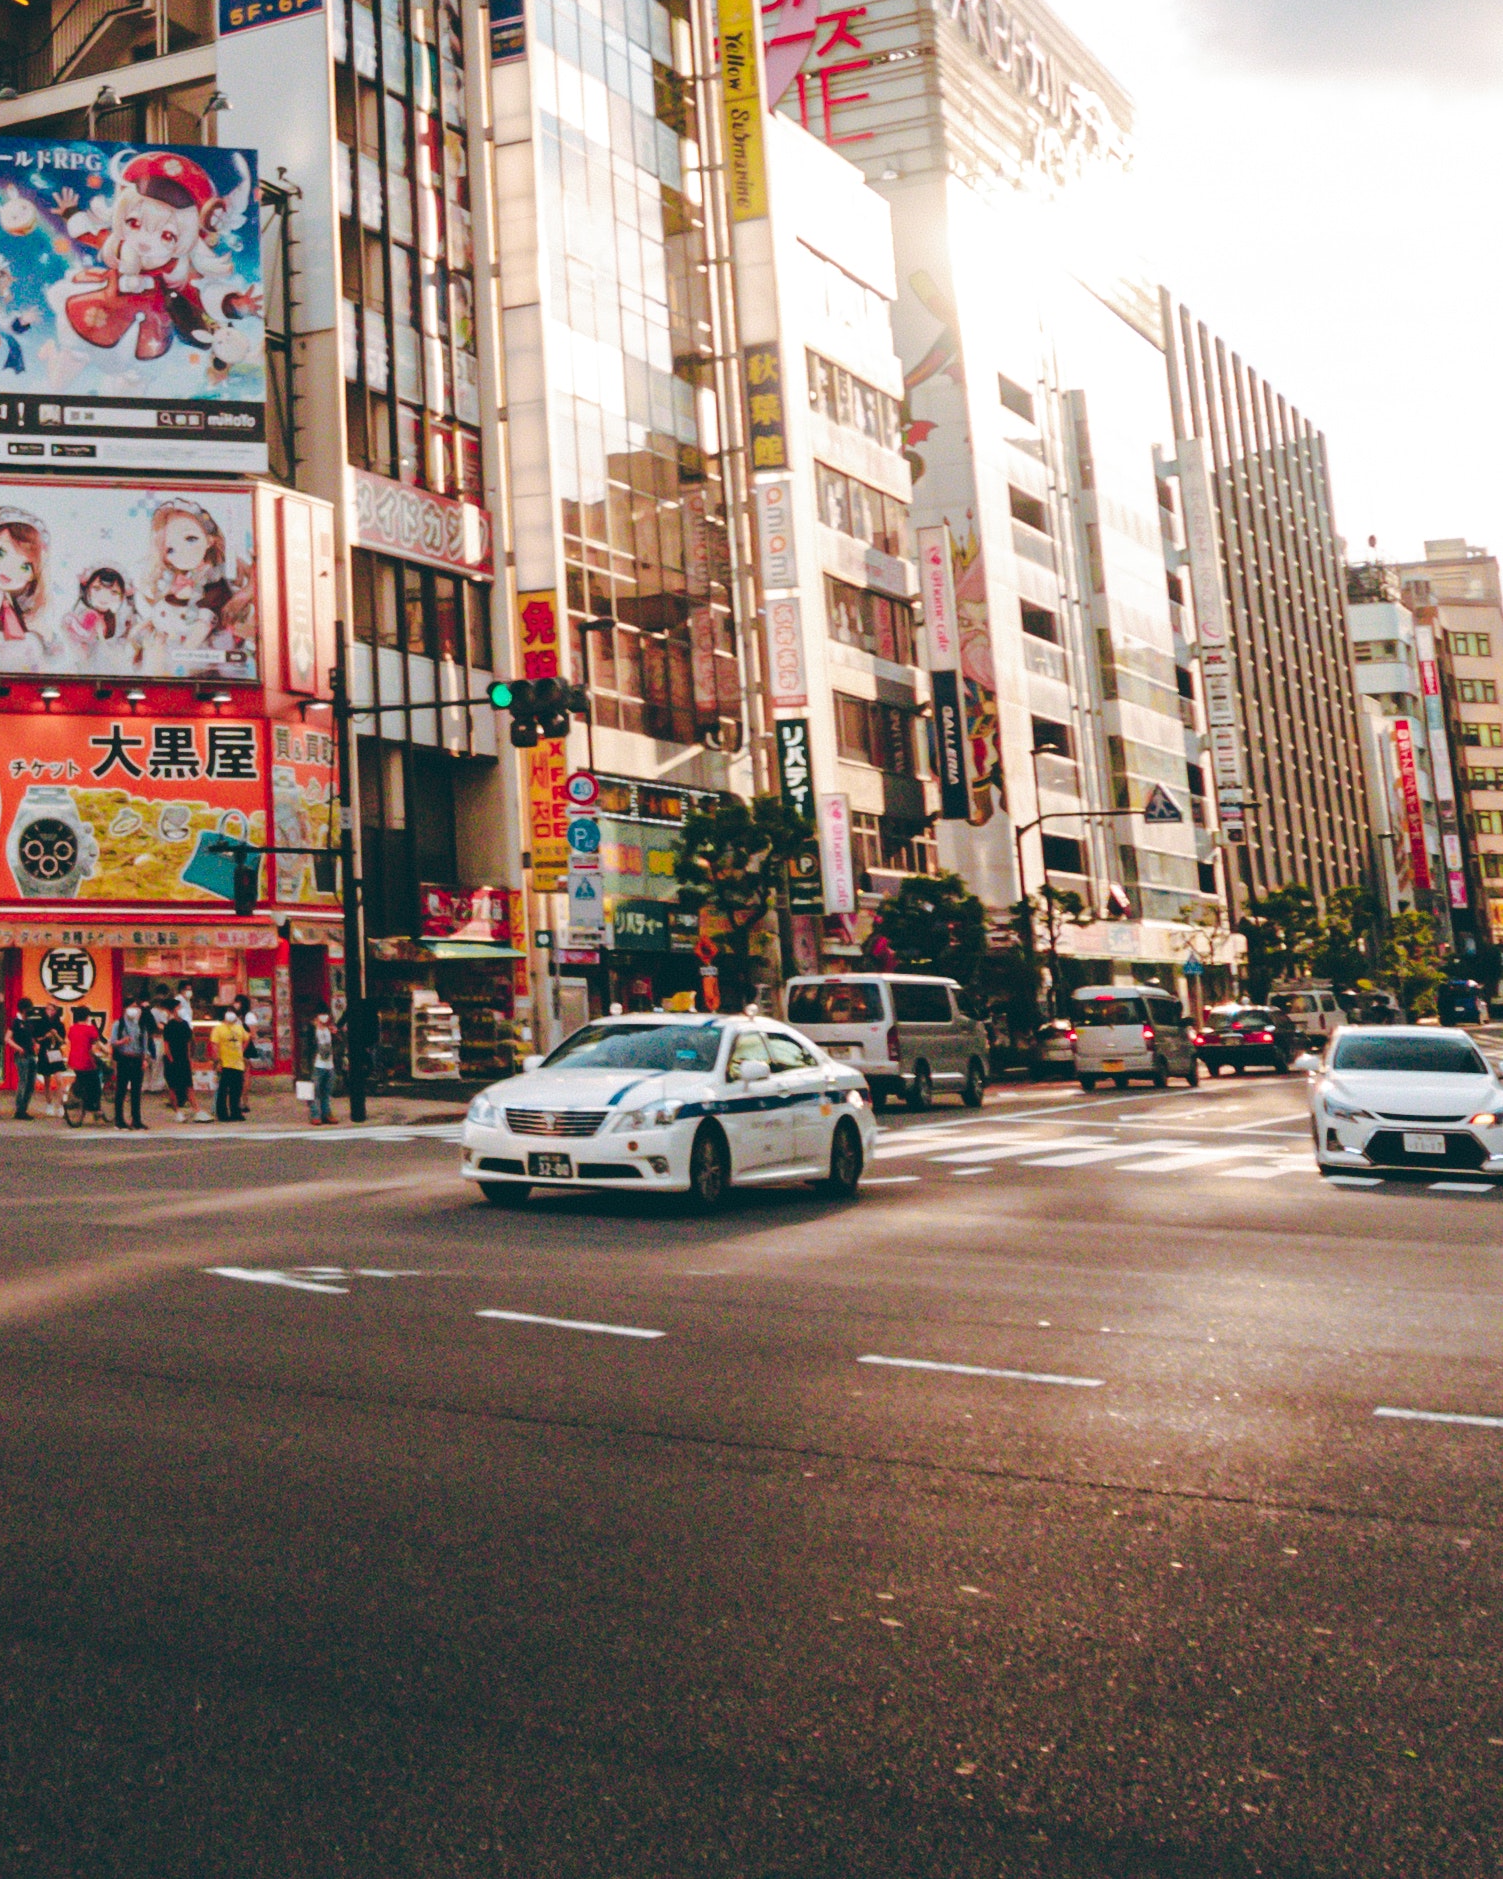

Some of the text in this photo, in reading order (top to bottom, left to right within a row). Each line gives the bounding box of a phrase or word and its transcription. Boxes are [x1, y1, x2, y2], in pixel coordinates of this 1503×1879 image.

[725, 31, 745, 91] Yellow
[730, 107, 753, 209] Submarine
[208, 413, 256, 428] miHoYo
[748, 351, 786, 467] 秋葉館
[767, 486, 790, 583] amiami
[10, 757, 79, 780] チケット
[91, 724, 258, 781] 大黒屋
[942, 705, 960, 785] GALLERIA
[47, 952, 89, 993] 質
